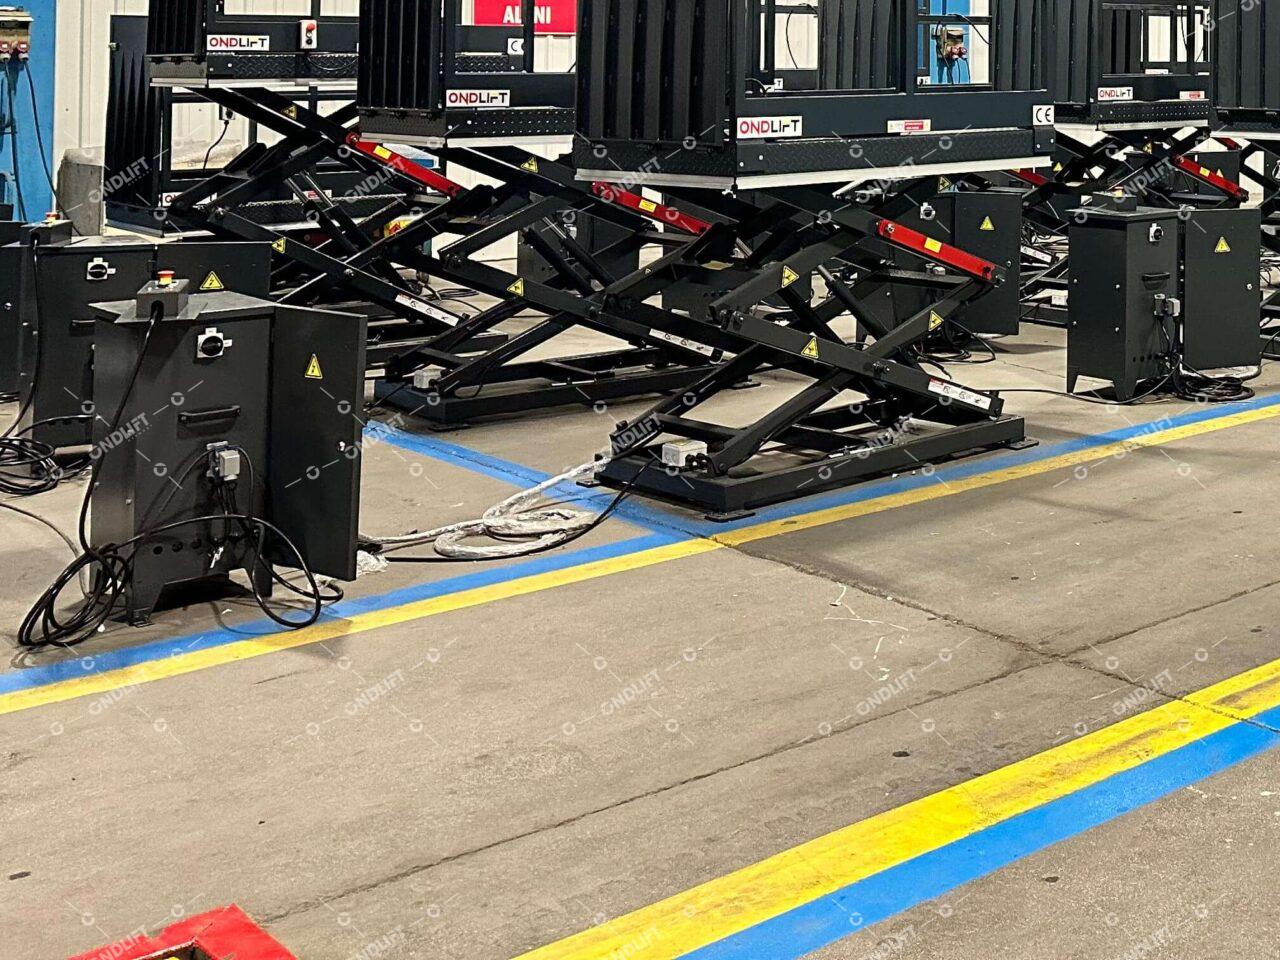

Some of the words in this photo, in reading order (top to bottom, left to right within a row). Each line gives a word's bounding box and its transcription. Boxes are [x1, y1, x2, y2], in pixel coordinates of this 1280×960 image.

[502, 5, 551, 24] ALNI
[209, 37, 267, 48] ONDLIFT
[448, 92, 508, 105] ONDLIFT
[739, 119, 800, 135] ONDLIFT
